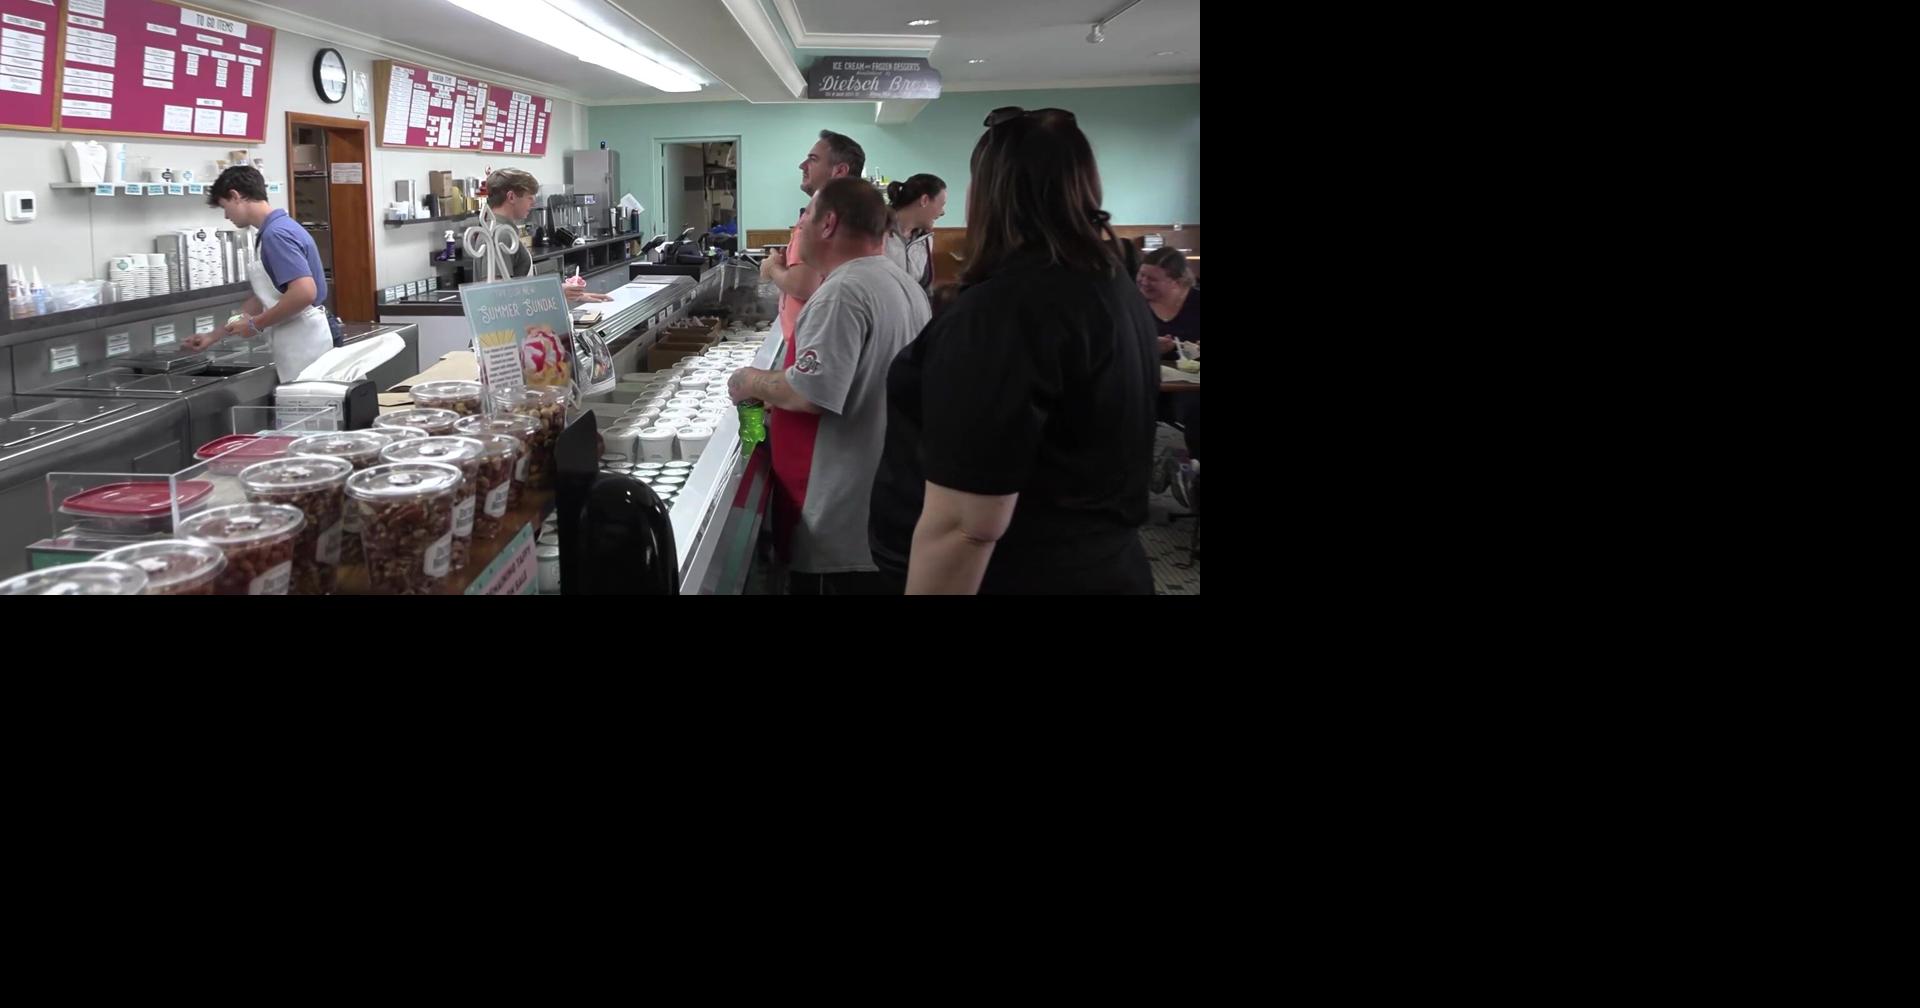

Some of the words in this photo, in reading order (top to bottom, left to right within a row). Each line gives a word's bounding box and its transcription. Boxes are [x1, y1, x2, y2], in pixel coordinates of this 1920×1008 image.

[196, 13, 205, 26] TO
[206, 16, 216, 29] GO
[833, 61, 843, 71] ICE
[844, 61, 865, 71] CREAM
[872, 62, 892, 71] FROZEN
[894, 62, 921, 71] DESSERTS
[820, 75, 879, 91] Dietsch
[479, 304, 520, 324] SUMMER
[522, 296, 559, 317] SUNDAE
[515, 545, 531, 567] TAFFY
[515, 567, 528, 592] SALE
